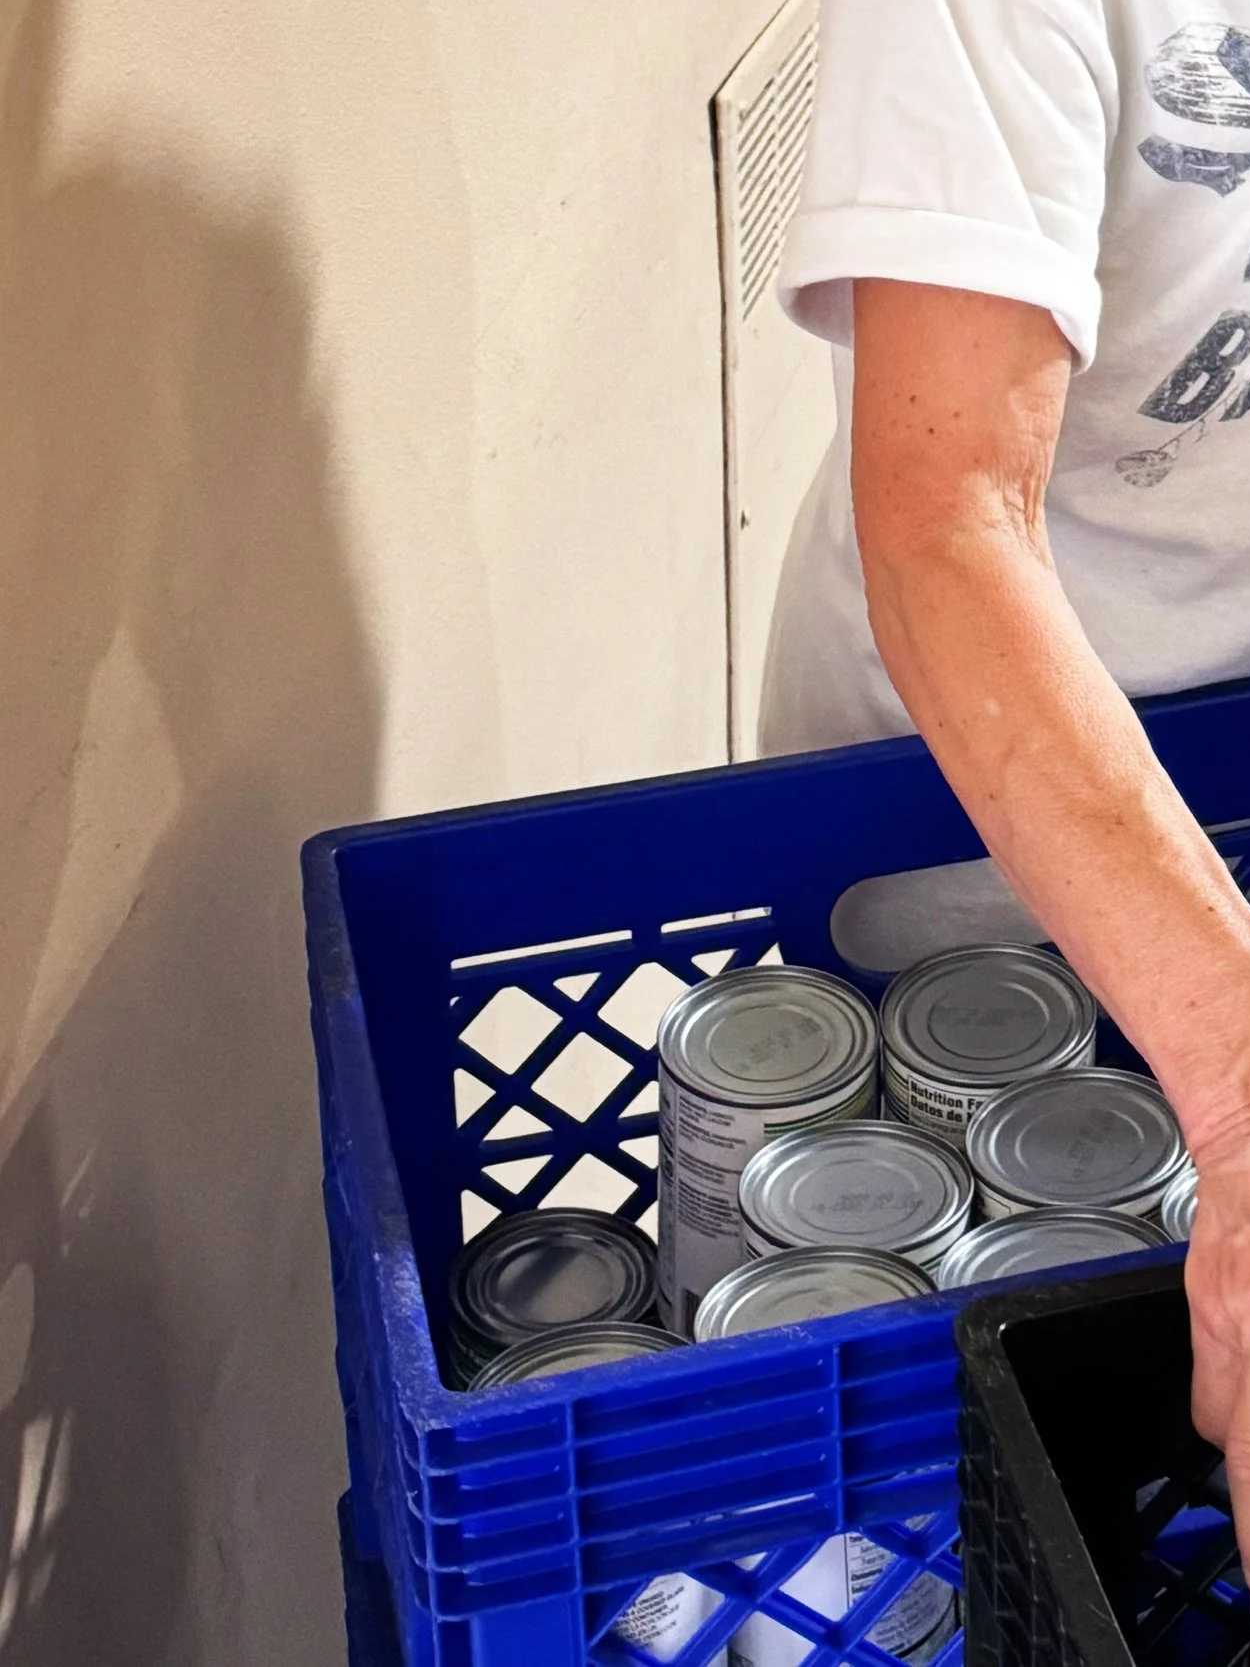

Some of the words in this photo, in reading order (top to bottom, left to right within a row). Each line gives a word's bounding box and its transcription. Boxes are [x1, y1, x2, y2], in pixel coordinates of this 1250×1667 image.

[910, 1080, 964, 1109] Nutrition
[910, 1094, 944, 1119] Datos
[946, 1109, 963, 1123] de
